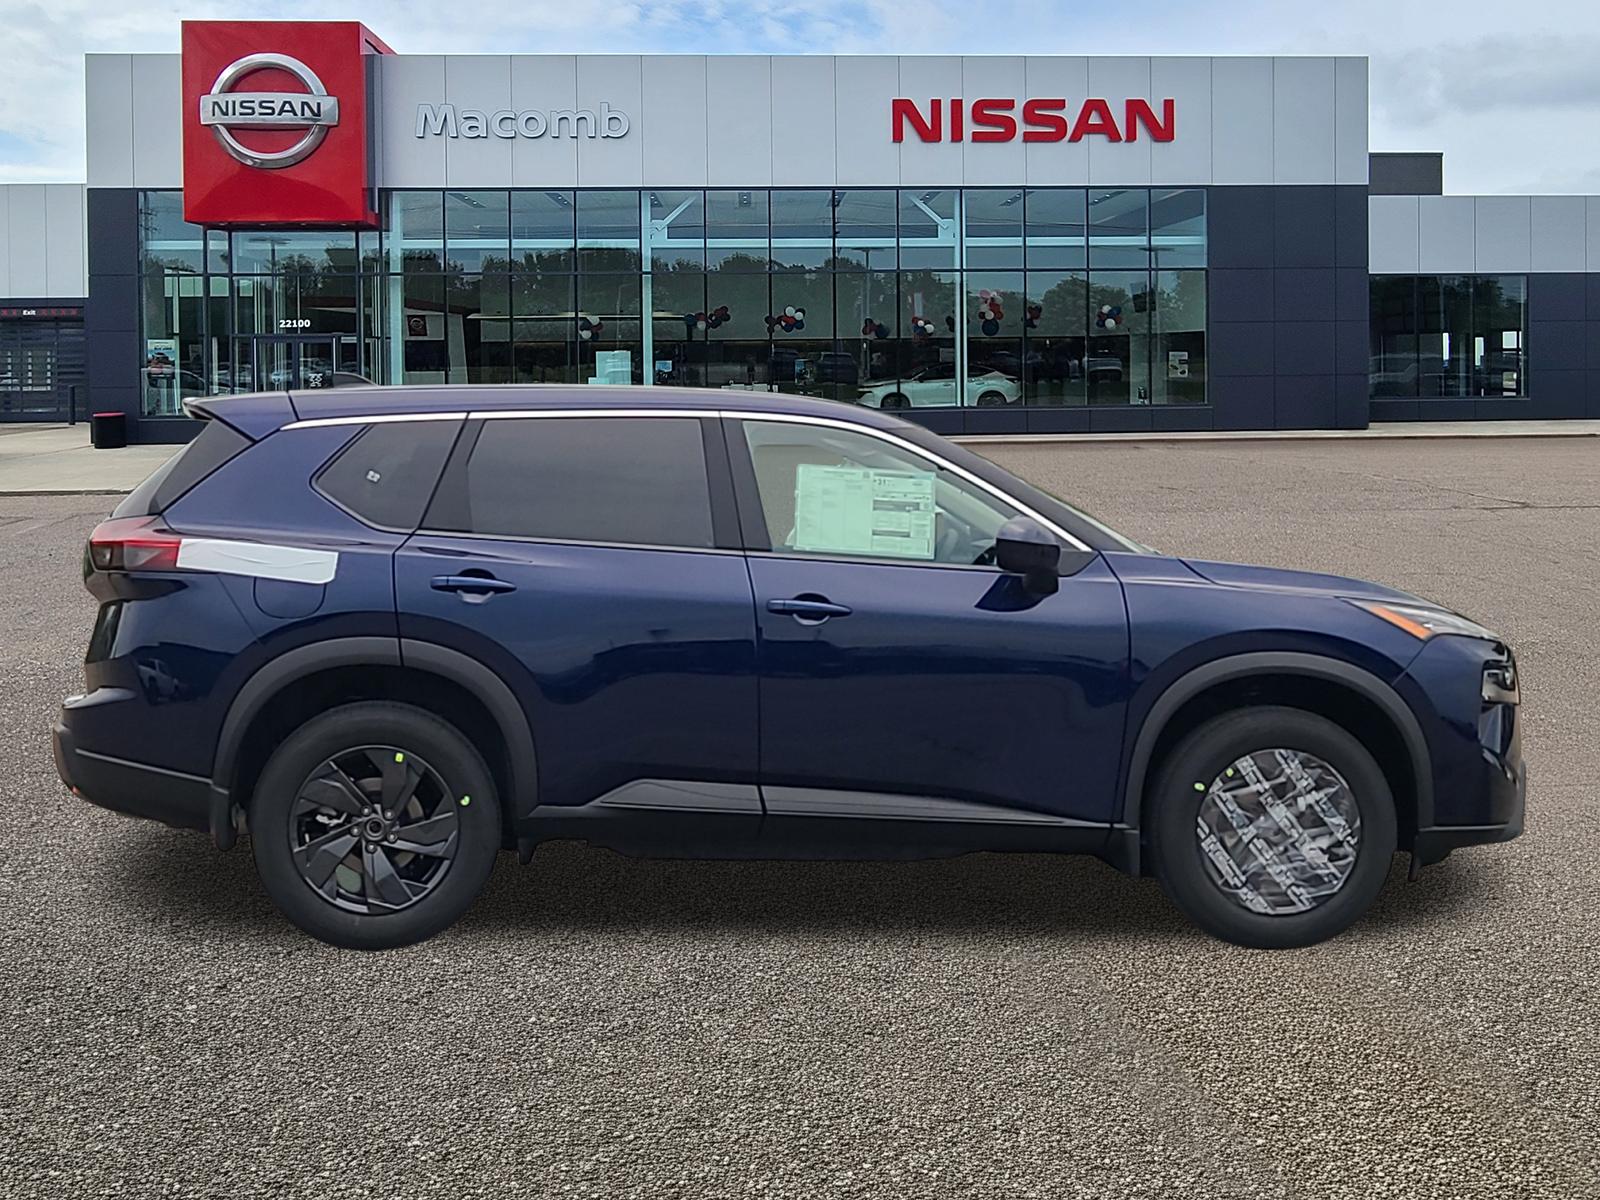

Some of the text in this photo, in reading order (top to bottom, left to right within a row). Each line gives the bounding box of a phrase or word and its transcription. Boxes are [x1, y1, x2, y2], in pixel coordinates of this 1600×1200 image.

[212, 100, 322, 118] NISSAN
[415, 102, 630, 139] Macomb
[892, 98, 1175, 143] NISSAN
[279, 319, 311, 328] 22100
